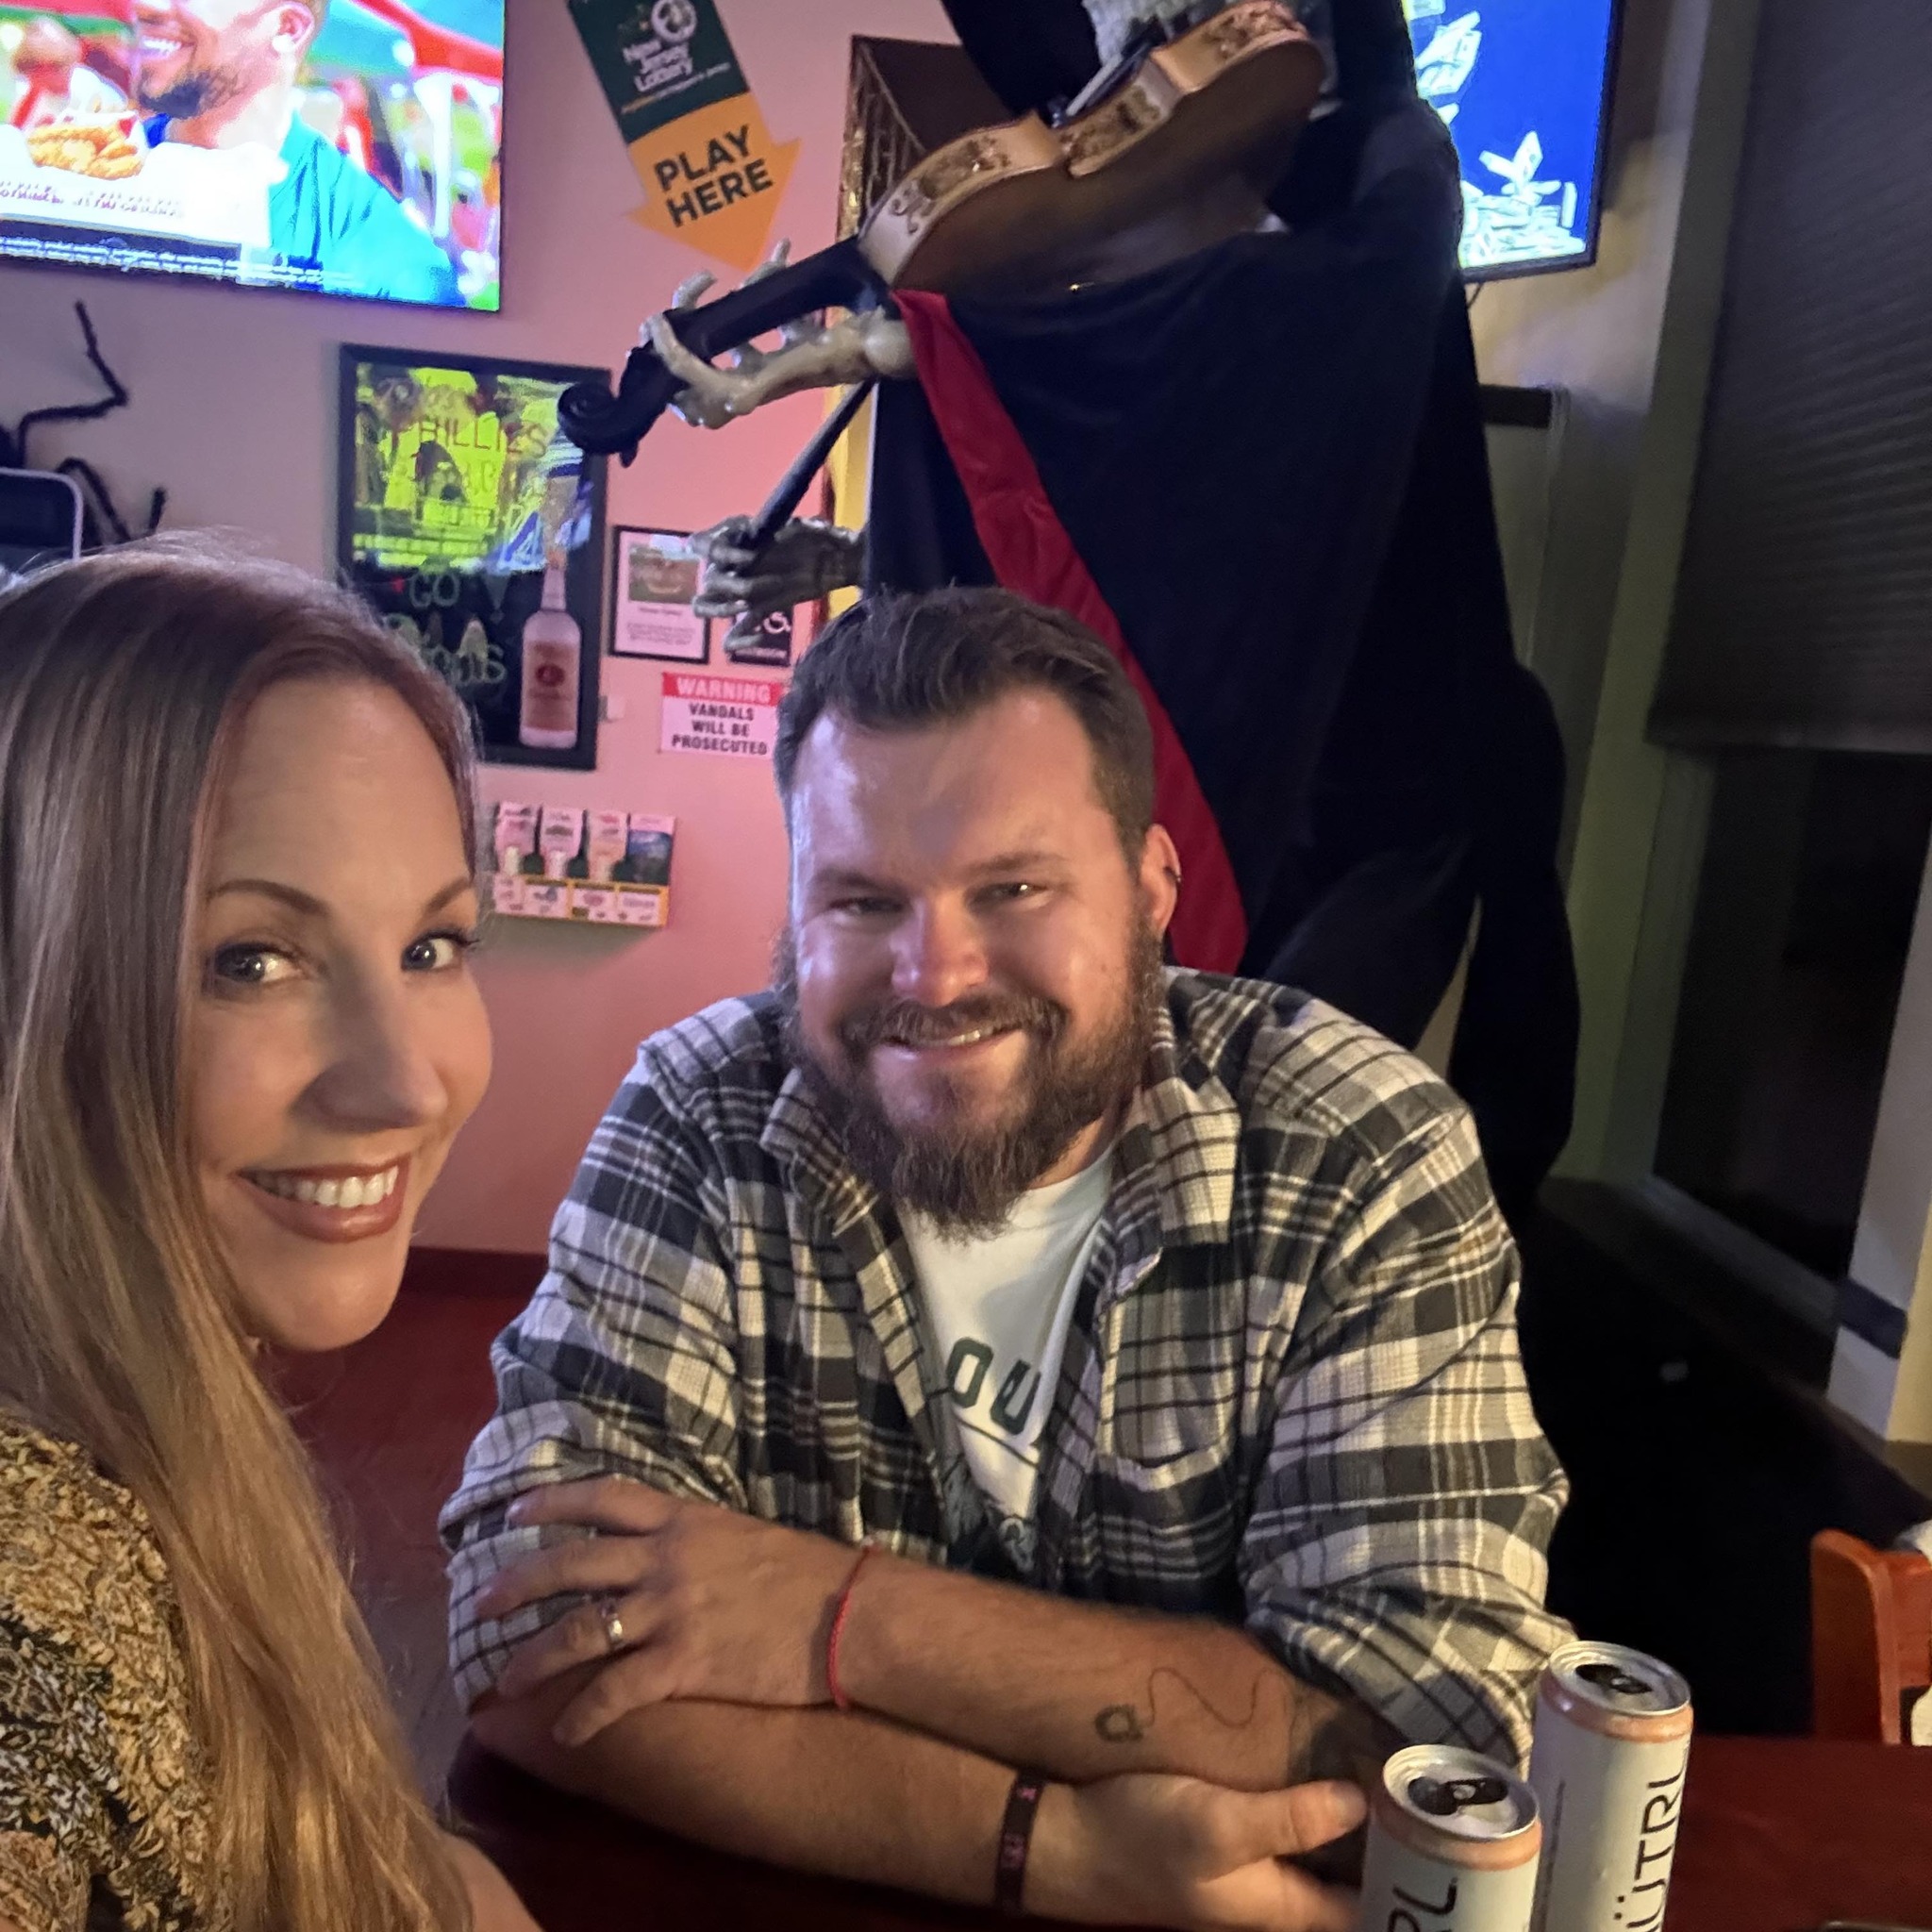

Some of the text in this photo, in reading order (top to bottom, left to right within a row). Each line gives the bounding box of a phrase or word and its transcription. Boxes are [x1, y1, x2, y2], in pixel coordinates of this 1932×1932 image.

[653, 124, 750, 192] PLAY
[666, 158, 773, 227] HERE
[678, 678, 771, 700] WARNING
[690, 704, 754, 720] VANDALS
[692, 722, 749, 737] WILL BE
[672, 735, 767, 755] PROSECUTED
[1613, 1772, 1683, 1932] ÜTRL
